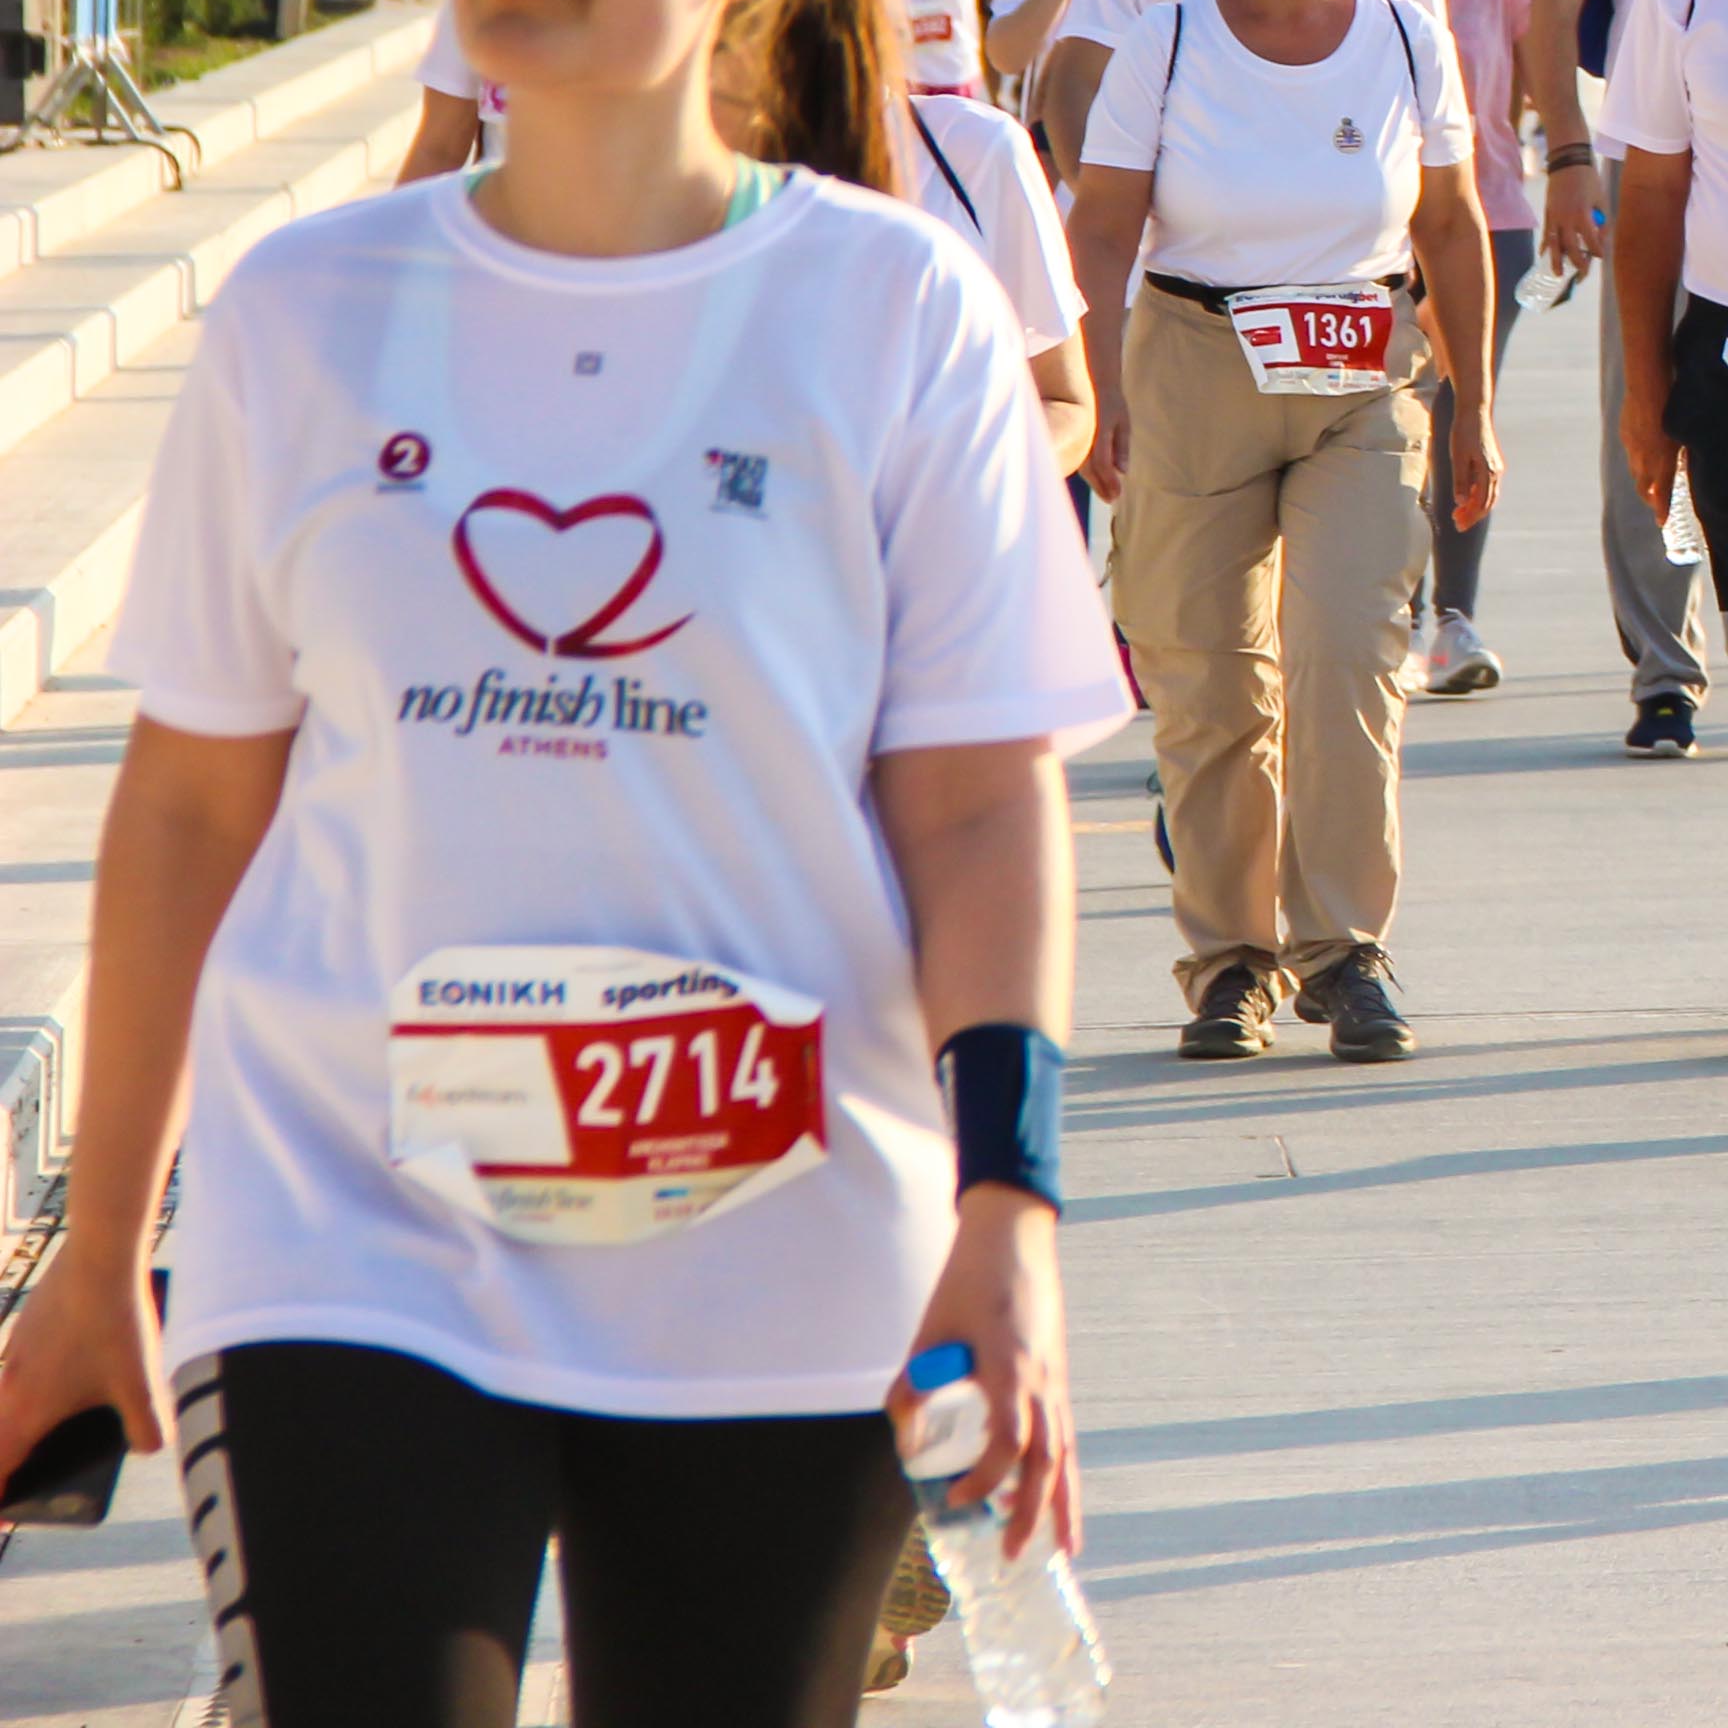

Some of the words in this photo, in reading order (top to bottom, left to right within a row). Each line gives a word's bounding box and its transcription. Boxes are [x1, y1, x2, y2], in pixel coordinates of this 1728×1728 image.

[1304, 312, 1373, 348] 1361
[390, 437, 422, 474] 2
[398, 683, 465, 725] no
[454, 667, 607, 738] finish
[612, 676, 709, 738] line
[498, 736, 609, 760] ATHENS
[576, 1022, 780, 1127] 2714
